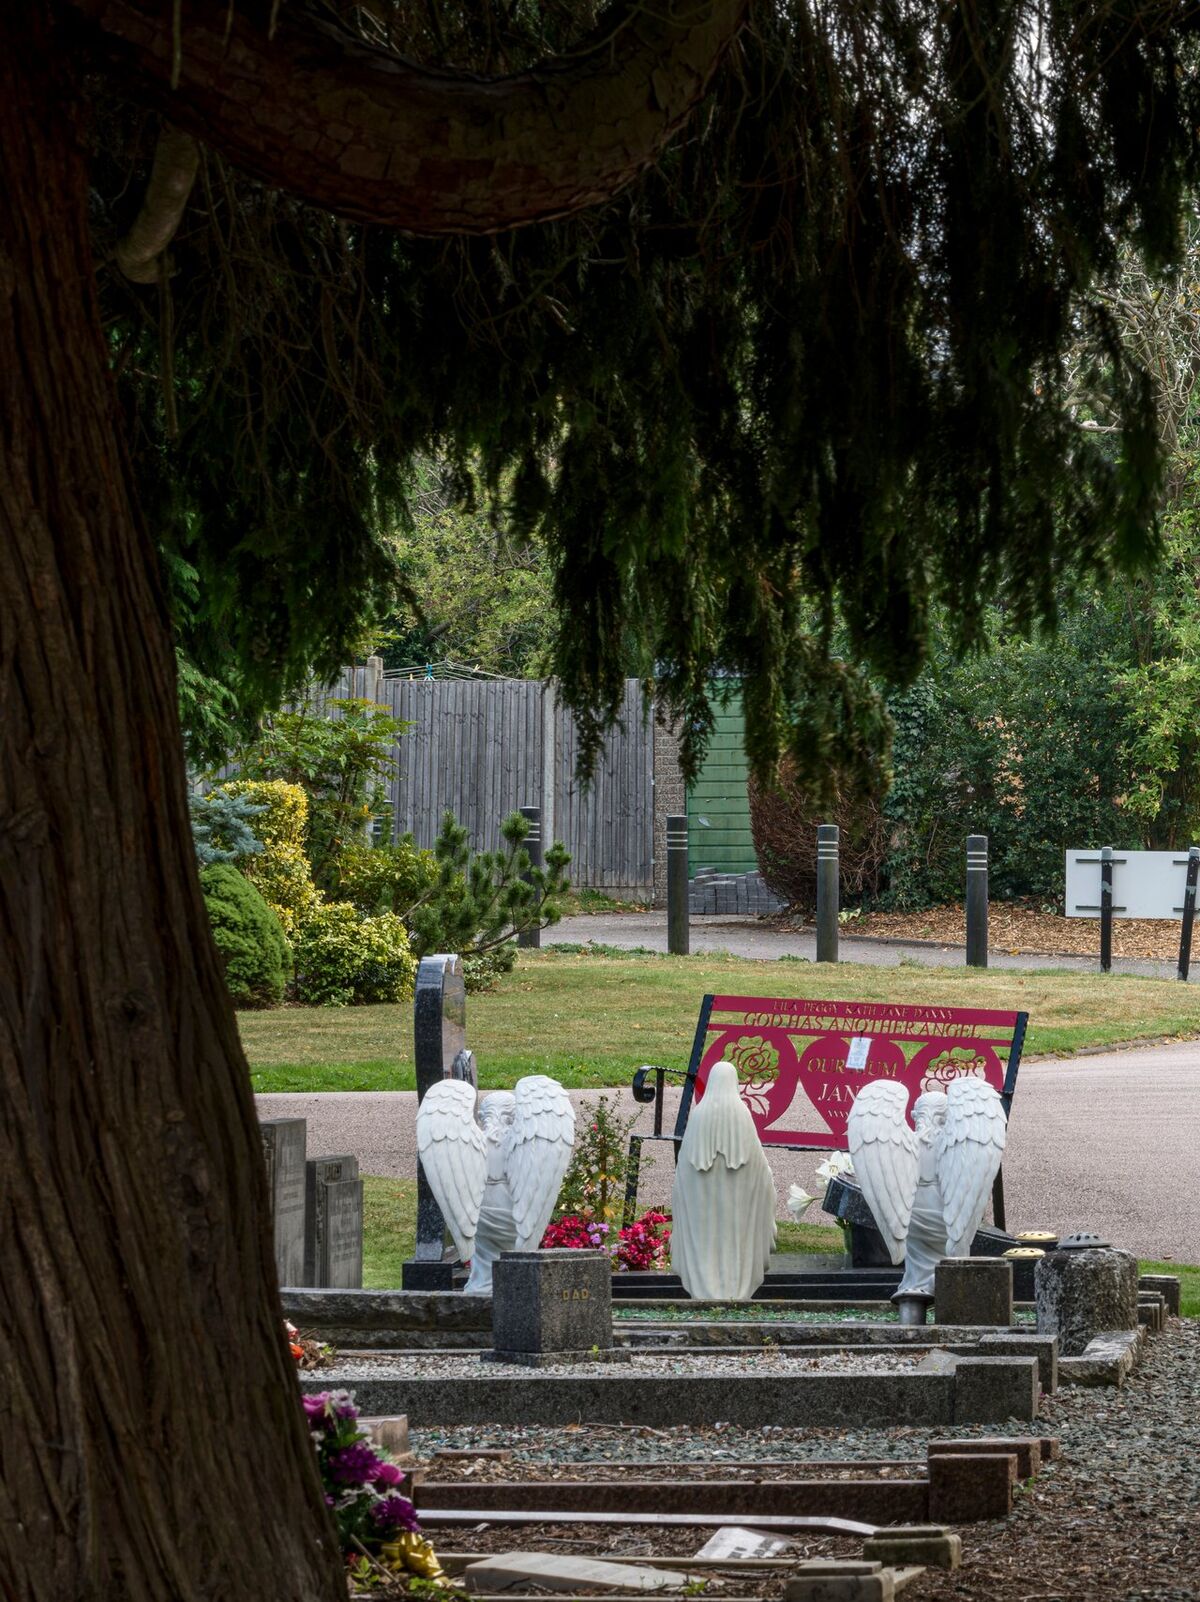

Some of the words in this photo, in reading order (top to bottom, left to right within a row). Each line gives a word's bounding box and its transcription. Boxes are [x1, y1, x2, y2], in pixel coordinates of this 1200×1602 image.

[744, 1011, 784, 1027] GOD
[786, 1014, 824, 1029] HAS
[828, 1016, 917, 1035] ANOTHER
[919, 1022, 983, 1039] ANGEL
[806, 1056, 846, 1074] OUR
[855, 1058, 898, 1077] UM
[817, 1083, 862, 1102] JAN
[562, 1288, 590, 1301] DAD
